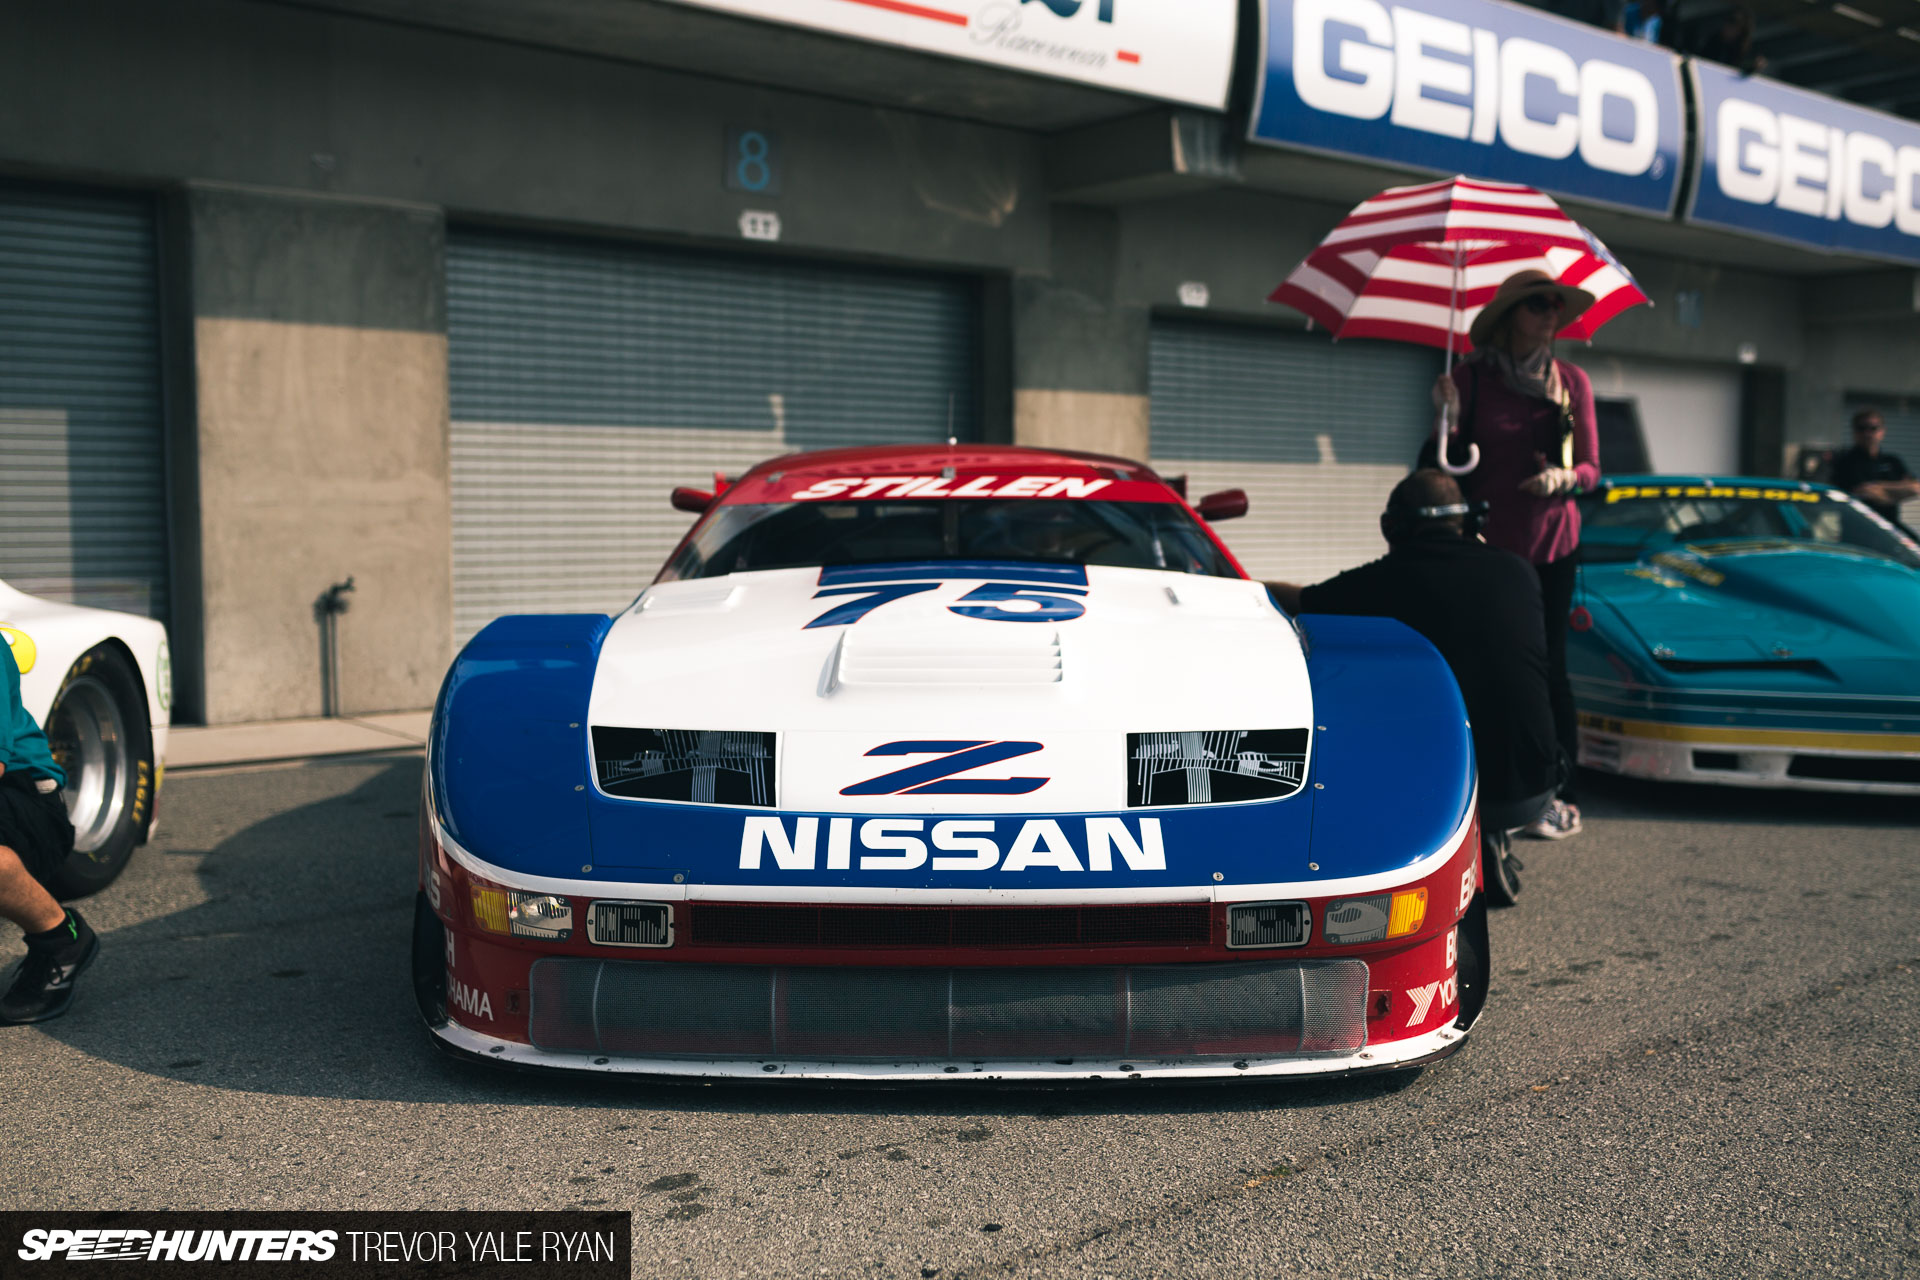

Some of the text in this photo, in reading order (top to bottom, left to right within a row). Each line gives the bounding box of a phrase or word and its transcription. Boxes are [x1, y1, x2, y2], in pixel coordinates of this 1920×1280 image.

[1293, 0, 1658, 176] GEICO
[738, 131, 770, 191] 8
[792, 476, 1112, 499] STILLEN
[1606, 486, 1820, 504] PETERSON
[801, 580, 1088, 629] 75
[132, 760, 148, 826] EAGLE
[839, 740, 1051, 796] Z
[739, 816, 1167, 872] NISSAN
[447, 973, 494, 1021] HAMA
